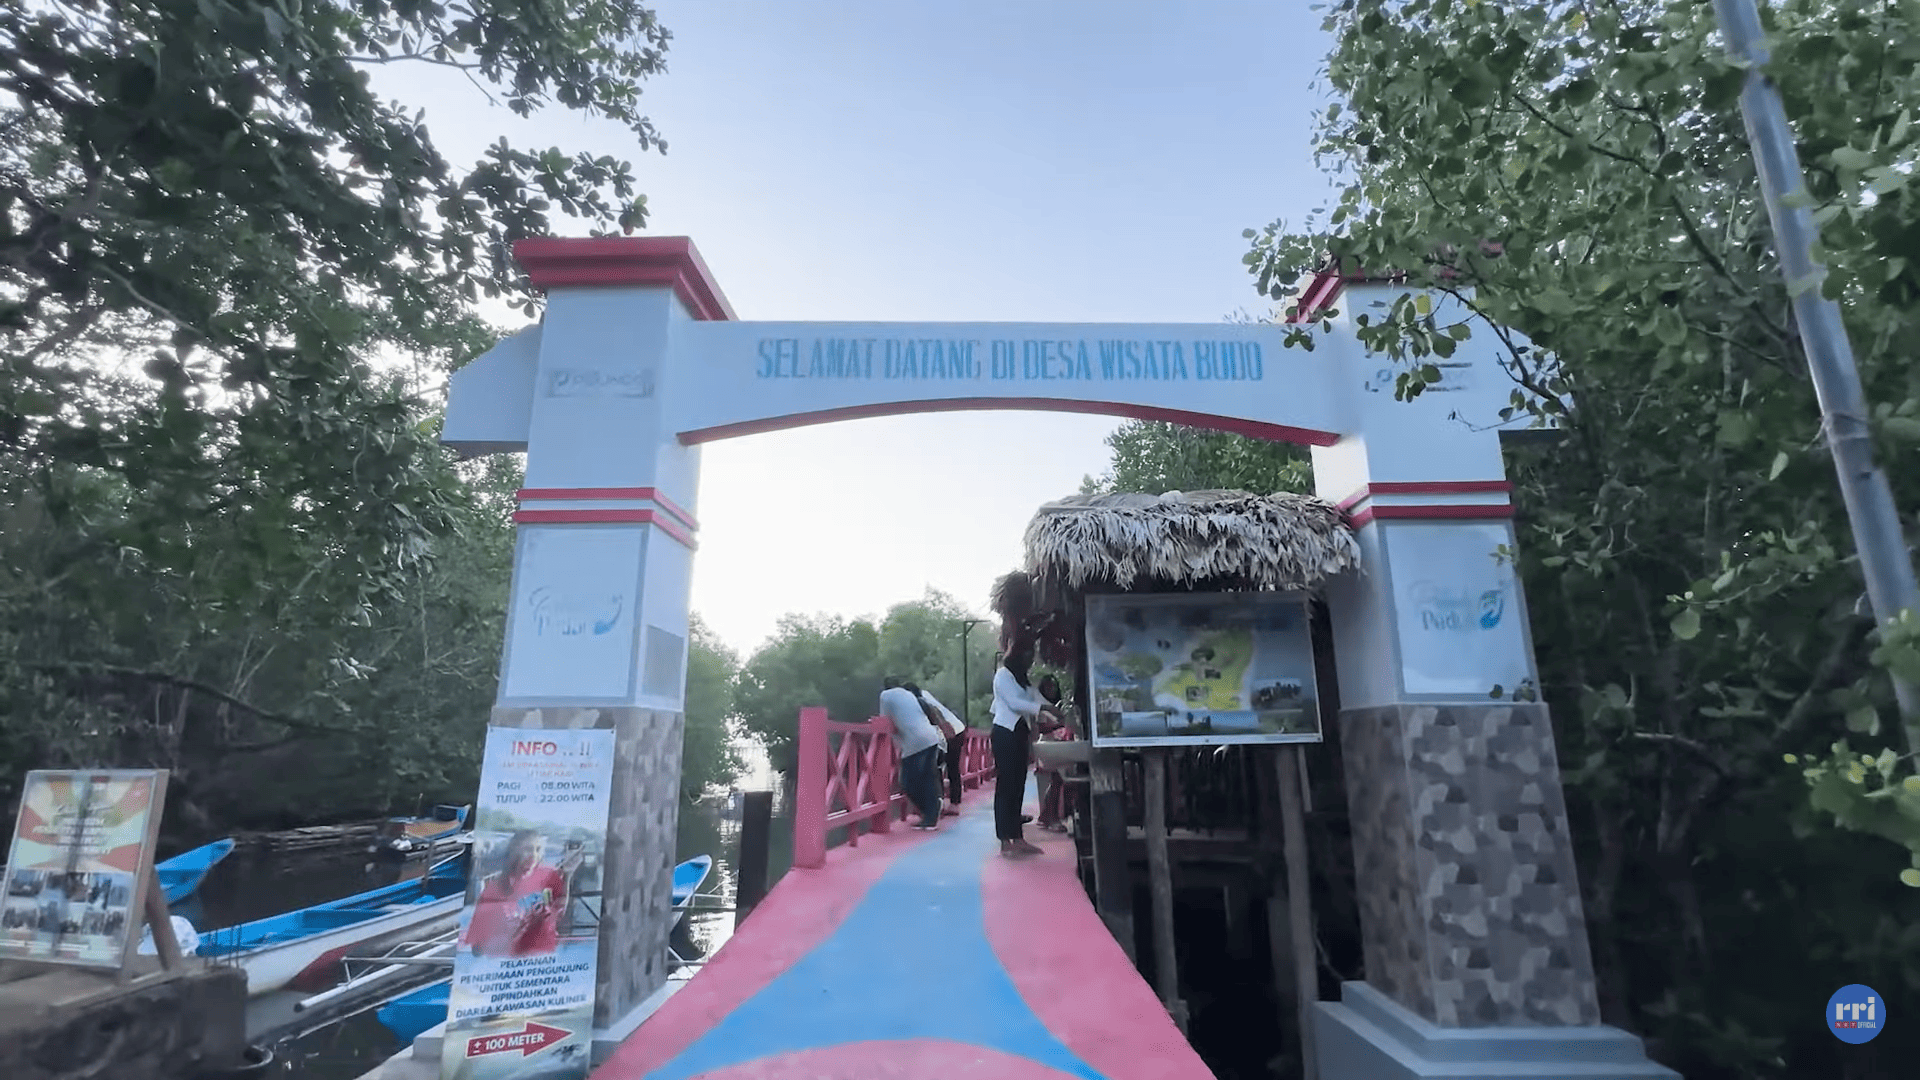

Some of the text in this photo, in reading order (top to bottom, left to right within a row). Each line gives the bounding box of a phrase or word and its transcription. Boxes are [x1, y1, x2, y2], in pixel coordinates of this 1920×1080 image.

[756, 338, 1263, 380] SELAMAT DATANG DI DESA WISATA BUDO
[511, 740, 557, 756] INFO
[497, 781, 521, 790] PAGI
[571, 781, 595, 790] WITA
[496, 794, 527, 803] TUTUP
[540, 794, 570, 803] 22.00
[571, 793, 595, 803] WITA
[500, 956, 556, 969] PELAYANAN
[460, 963, 590, 984] PENERIMAAN PENGUNJUNG
[479, 974, 571, 993] UNTUK SEMENTARA
[491, 986, 558, 1003] DIPINDAHKAN
[456, 1005, 493, 1018] DIAREA
[495, 999, 545, 1013] KAWASAN
[485, 1038, 506, 1050] 100
[507, 1032, 545, 1047] METER
